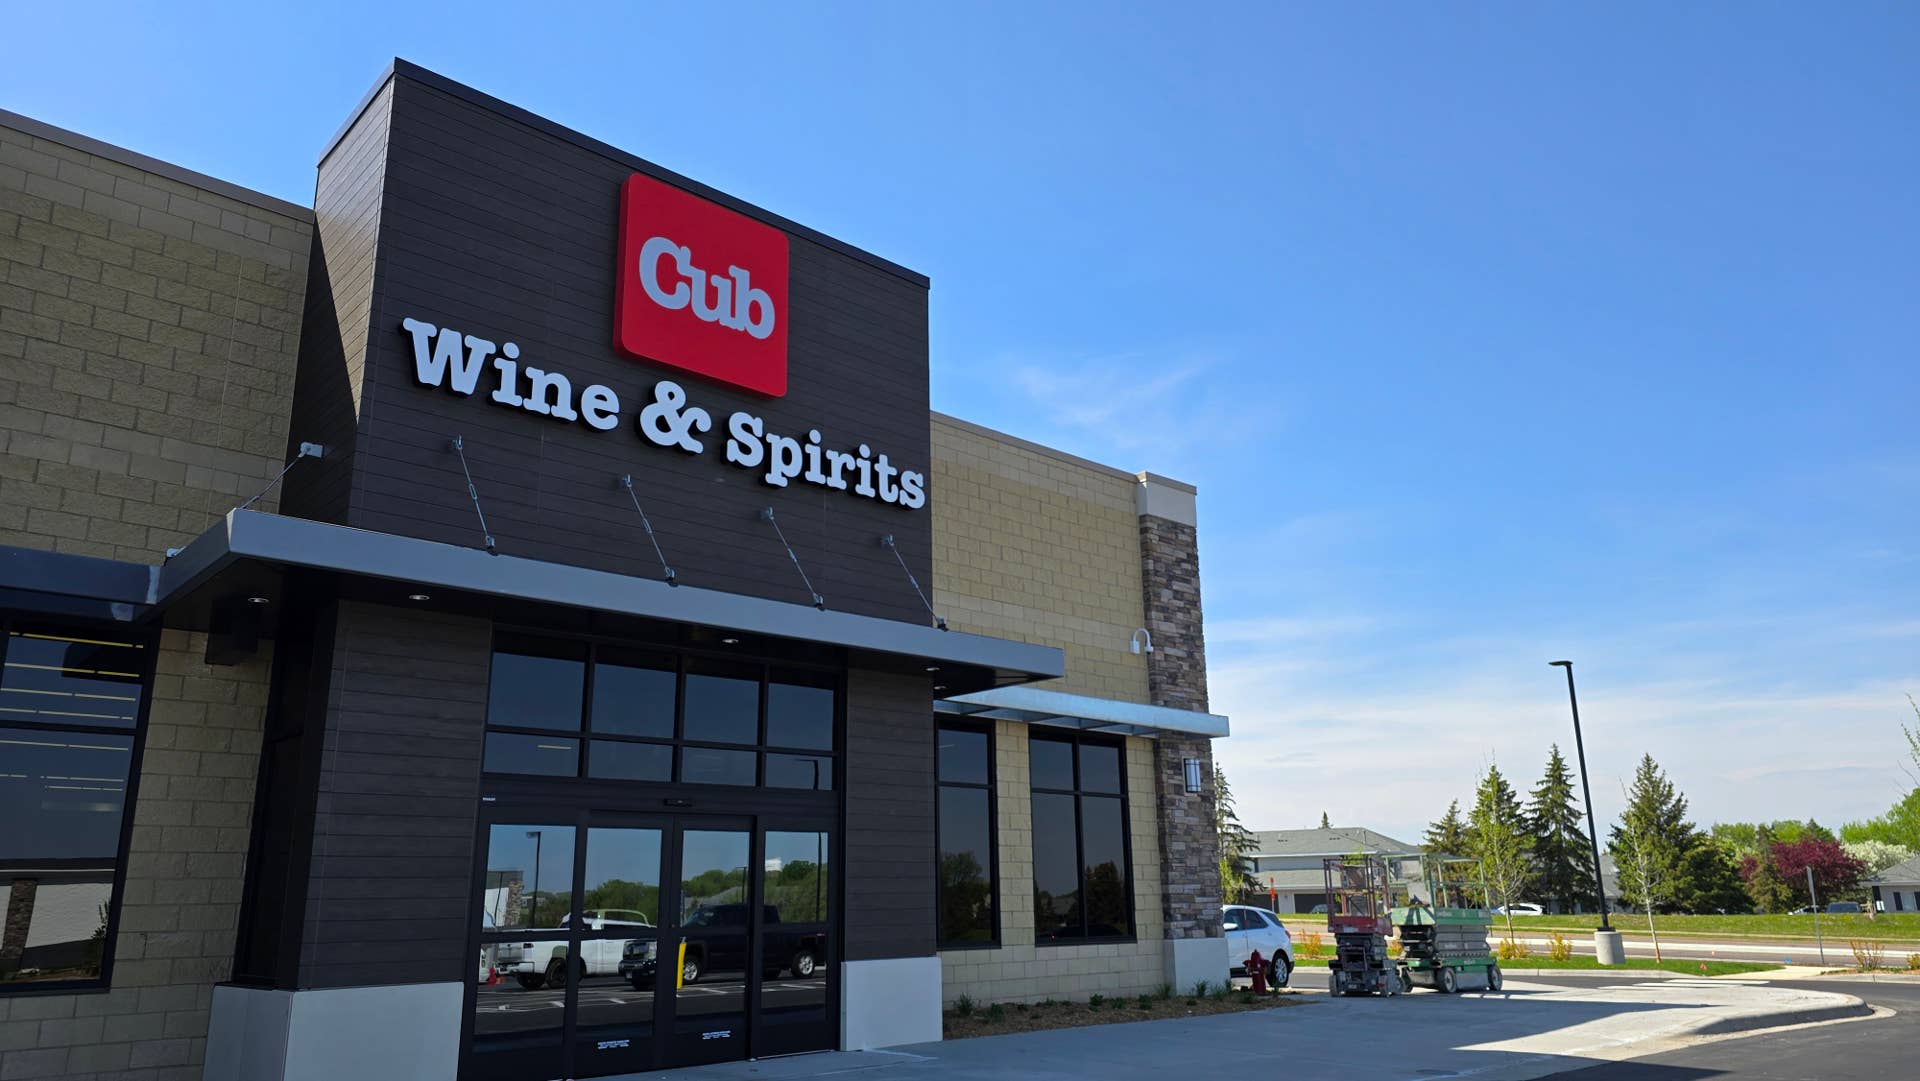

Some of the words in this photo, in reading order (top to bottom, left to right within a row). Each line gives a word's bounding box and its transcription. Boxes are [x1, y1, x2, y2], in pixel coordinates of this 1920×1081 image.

[639, 236, 775, 339] Cub
[402, 317, 620, 431] Wine
[639, 380, 712, 454] &
[726, 411, 926, 509] Spirits
